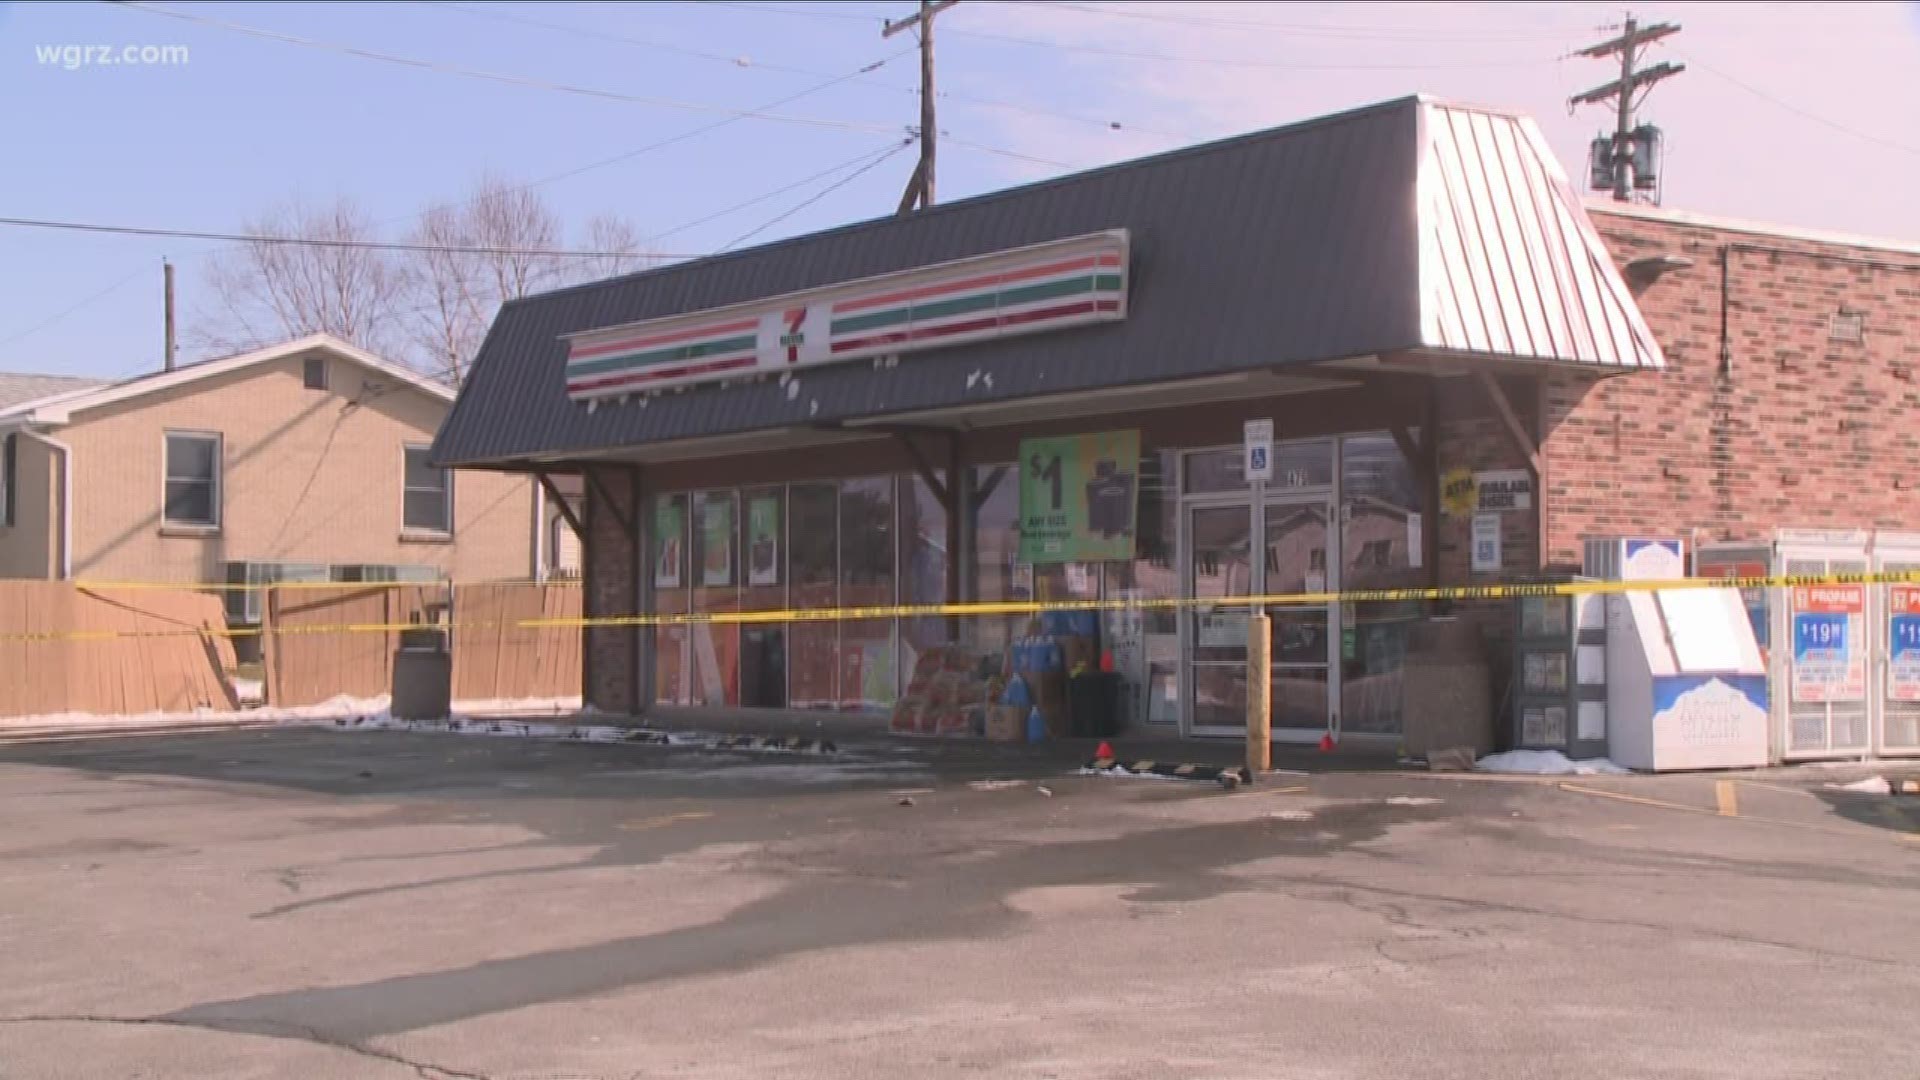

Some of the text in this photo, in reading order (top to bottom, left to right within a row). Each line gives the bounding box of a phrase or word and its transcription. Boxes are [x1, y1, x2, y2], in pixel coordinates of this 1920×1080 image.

[783, 307, 807, 363] 7
[1030, 453, 1062, 510] $1
[1811, 588, 1861, 605] PROPANE
